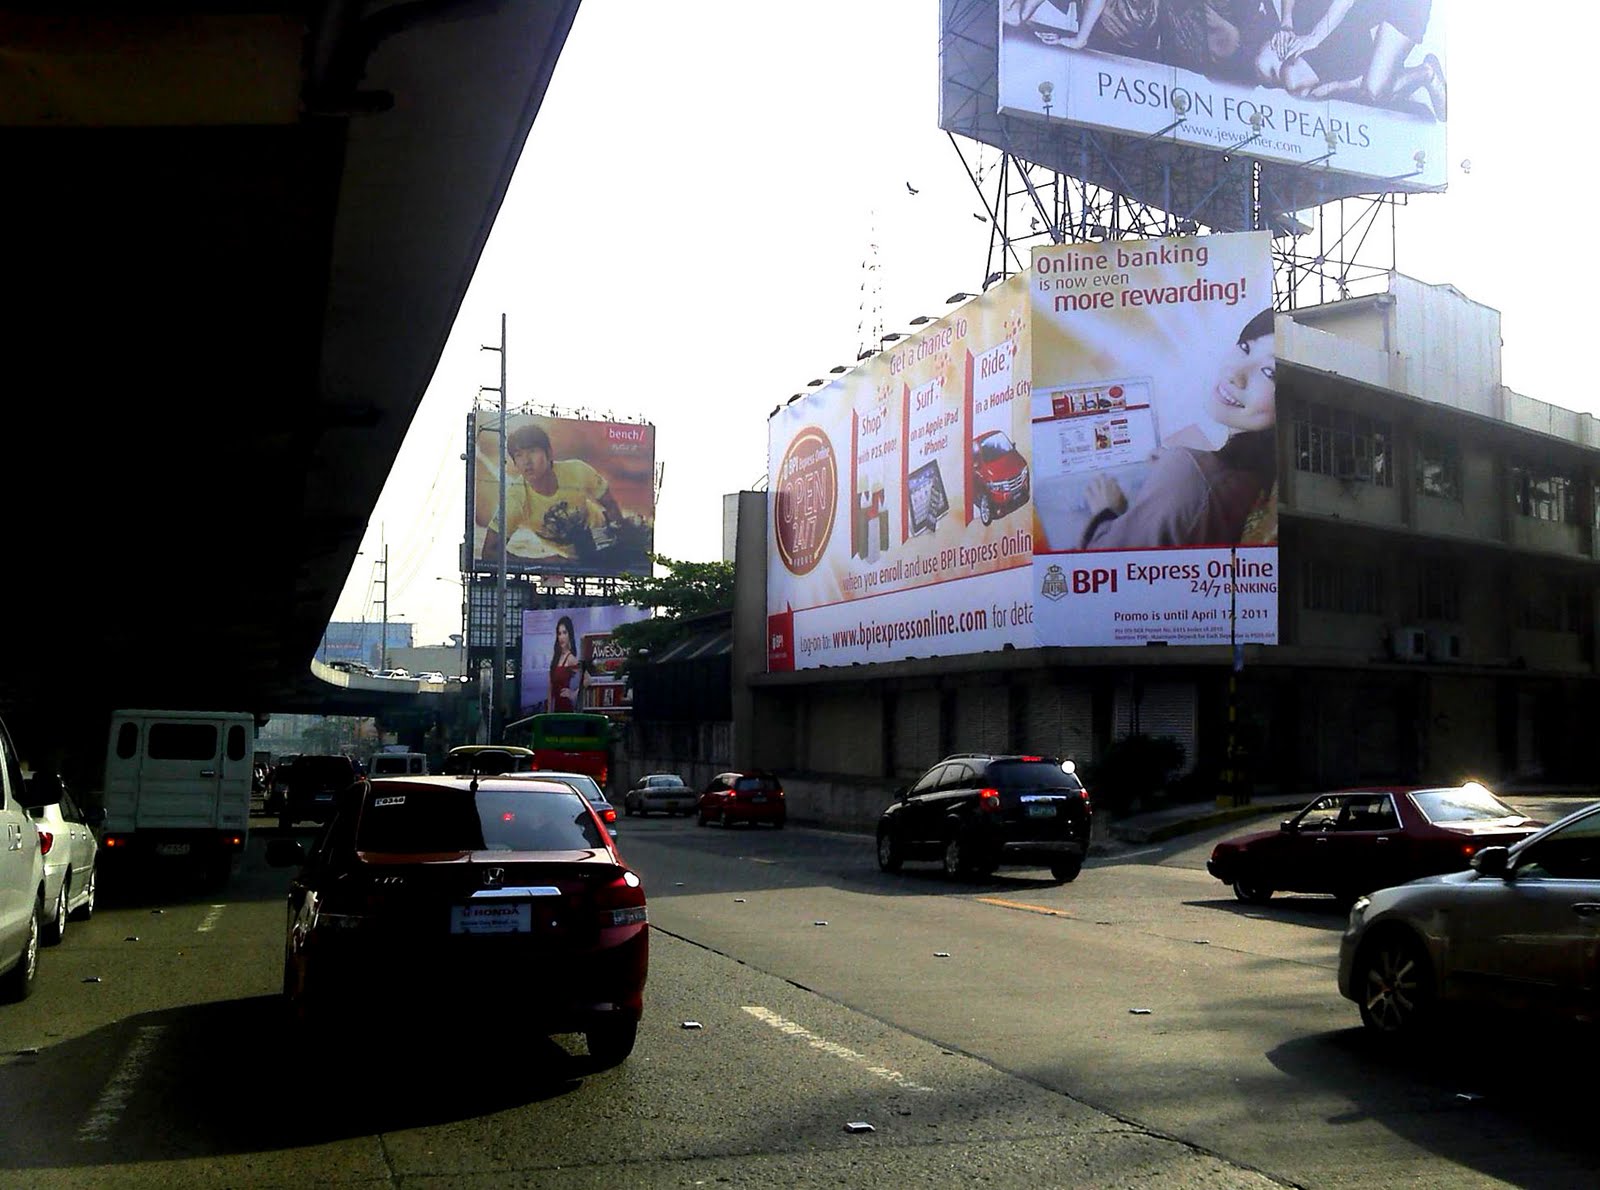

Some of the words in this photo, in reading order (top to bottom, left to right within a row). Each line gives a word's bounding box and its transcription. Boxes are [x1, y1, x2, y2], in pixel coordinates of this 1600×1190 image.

[1098, 72, 1213, 118] PASSION
[1223, 97, 1276, 130] FOR
[1284, 109, 1371, 148] PEARLS
[1037, 252, 1108, 274] Online
[1117, 244, 1208, 267] banking
[1039, 278, 1050, 291] is
[1055, 277, 1088, 290] now
[1093, 273, 1129, 287] even
[1055, 291, 1114, 312] more
[1121, 278, 1246, 307] rewarding!
[889, 352, 906, 376] Get
[908, 347, 914, 367] a
[916, 327, 953, 361] chance
[956, 318, 967, 340] to
[981, 349, 1005, 379] Ride
[916, 382, 935, 411] Surf
[975, 400, 983, 414] in
[990, 385, 1015, 408] Honda
[1016, 379, 1032, 397] City
[862, 415, 882, 436] Shop
[926, 416, 944, 437] Apple
[783, 466, 827, 524] OPEN
[864, 570, 878, 593] you
[880, 560, 903, 584] enroll
[905, 555, 920, 579] and
[922, 556, 938, 575] use
[941, 548, 957, 571] BPI
[960, 543, 998, 570] Express
[1001, 529, 1032, 557] Onlin
[1073, 568, 1118, 594] BPI
[1127, 563, 1200, 585] Express
[1207, 558, 1273, 578] Online
[1191, 580, 1221, 598] 24/7
[1224, 582, 1277, 594] BANKING
[832, 609, 987, 650] www.bpiexpressonline.com
[993, 603, 1007, 629] for
[1114, 611, 1149, 622] Promo
[1152, 610, 1160, 621] is
[1164, 609, 1188, 620] until
[1192, 609, 1217, 622] April
[1242, 608, 1268, 619] 2011
